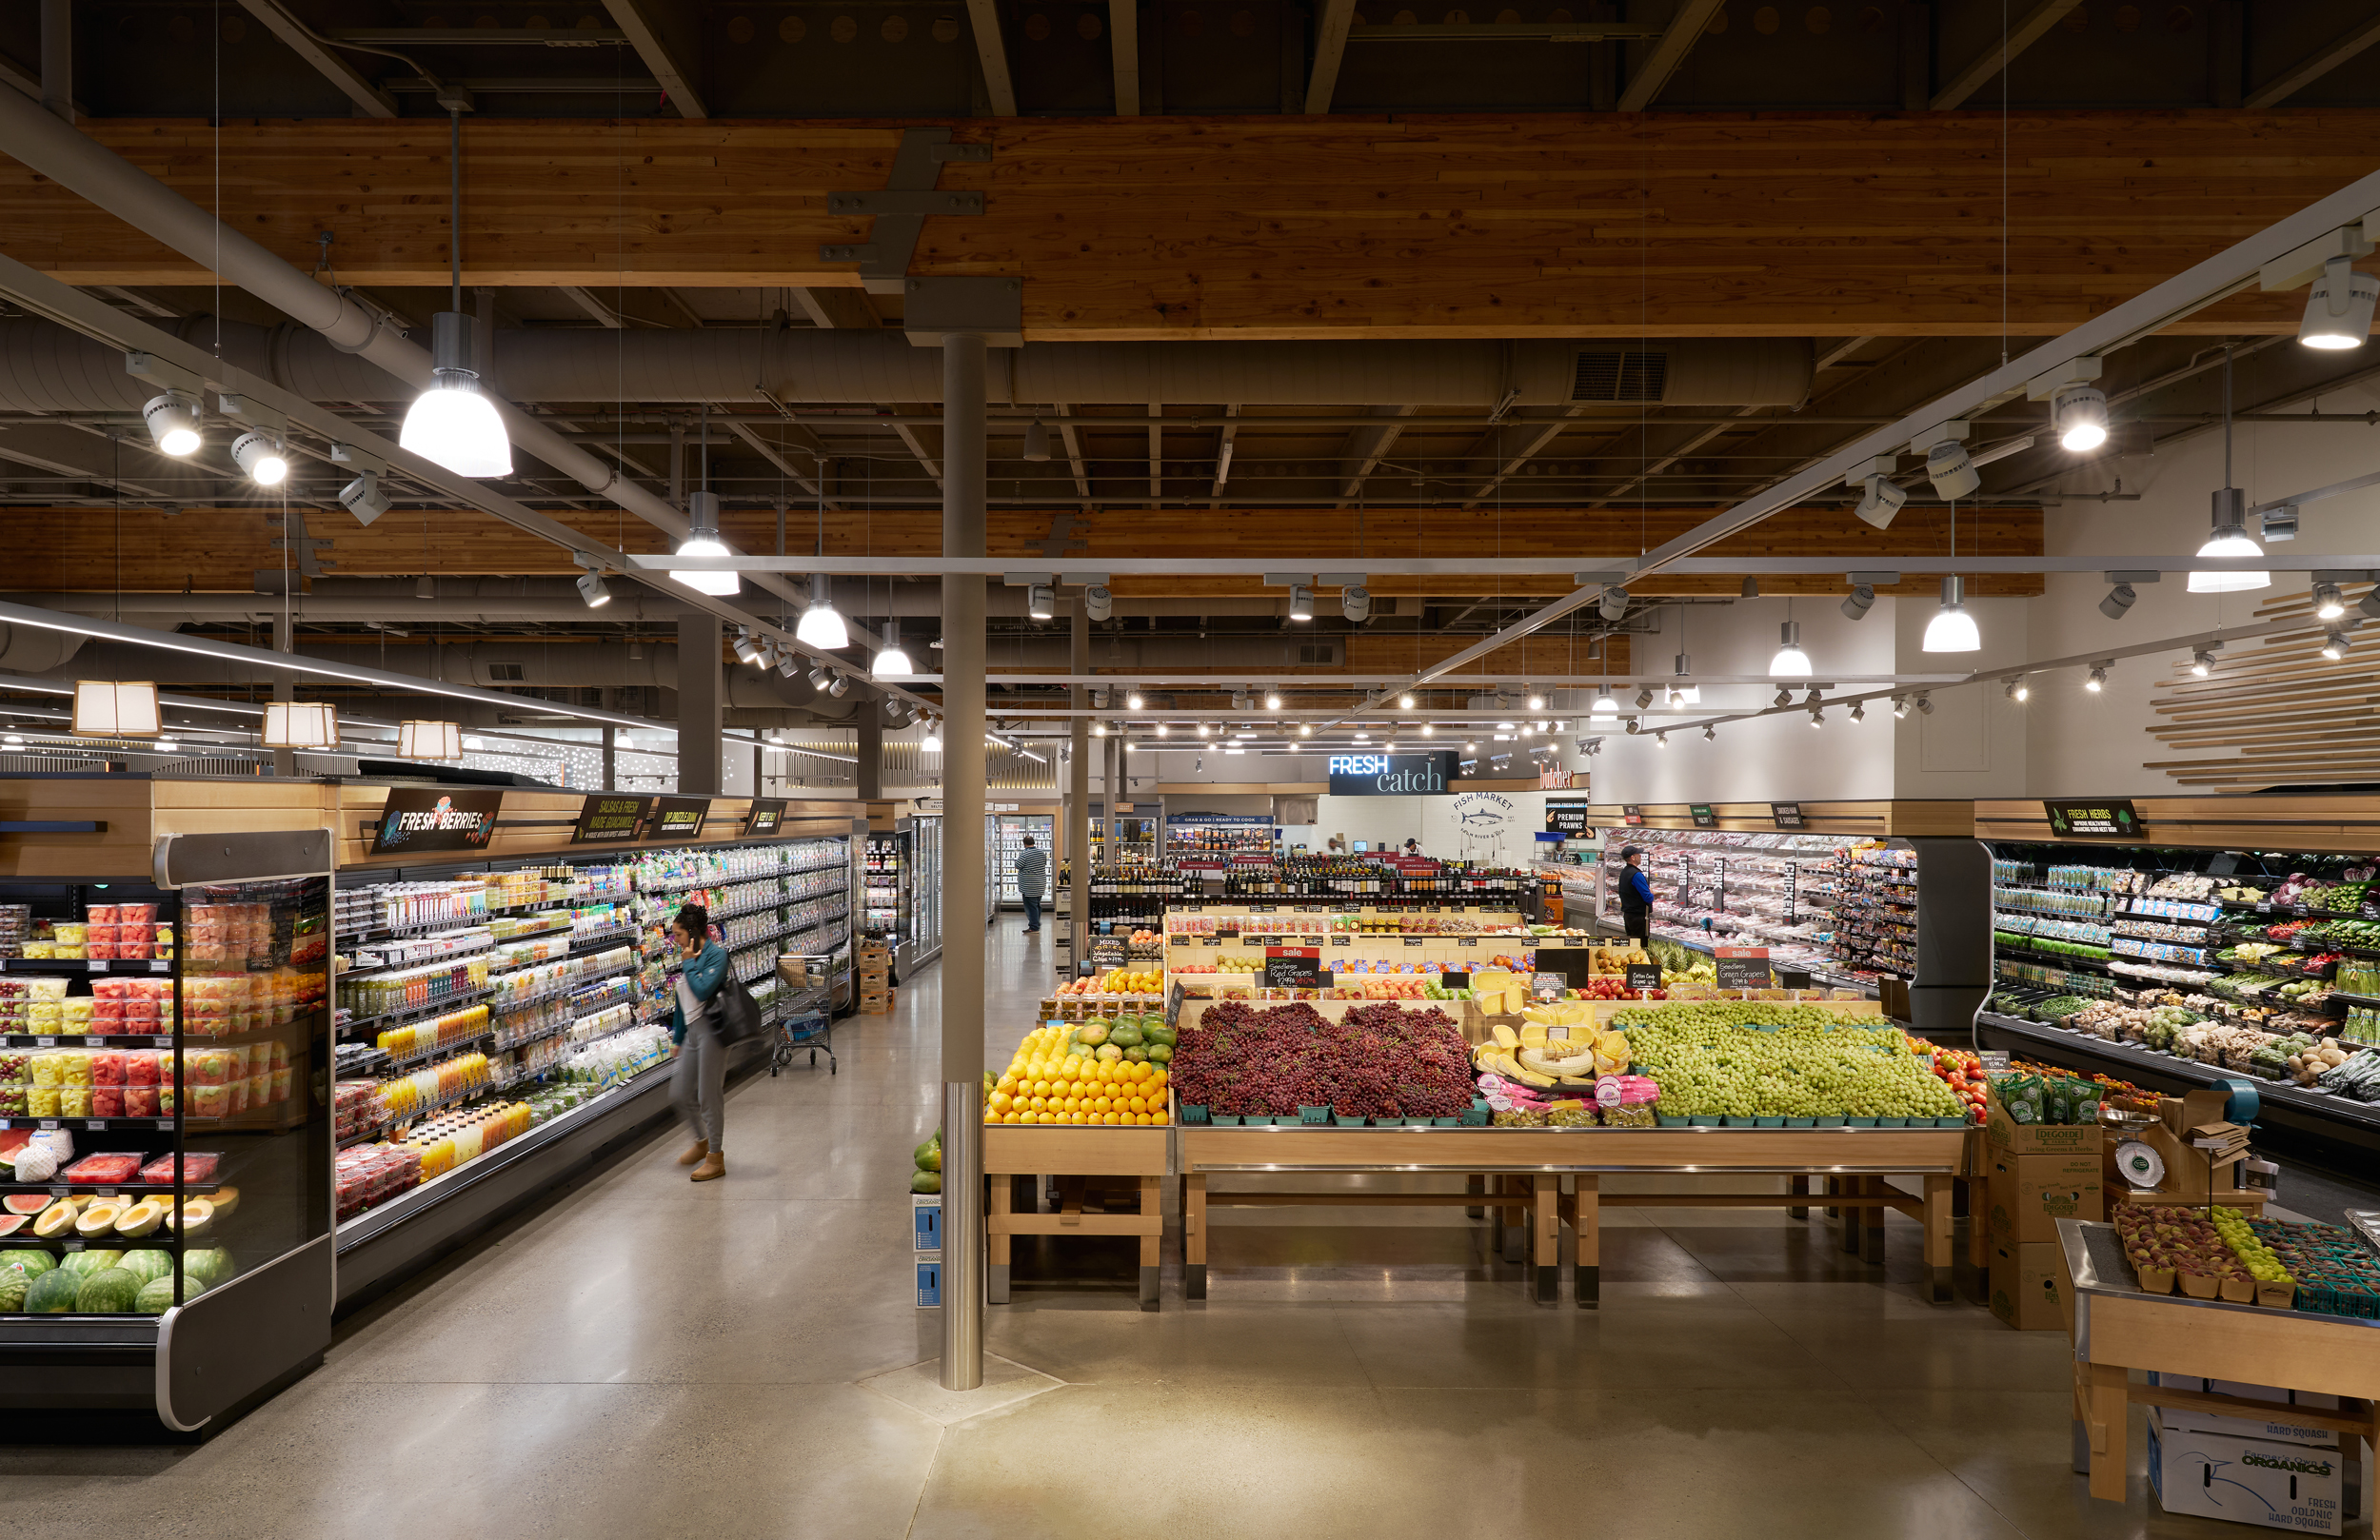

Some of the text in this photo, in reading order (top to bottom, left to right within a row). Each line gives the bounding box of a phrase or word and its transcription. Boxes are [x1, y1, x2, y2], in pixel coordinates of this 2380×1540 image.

[1329, 755, 1388, 775] FRESH
[1377, 761, 1443, 792] catch
[1539, 761, 1574, 789] butcher
[625, 801, 640, 813] FRESH
[1454, 792, 1514, 810] FISH MARKET
[398, 812, 483, 831] FRESH BERRIES
[2067, 809, 2112, 819] FRESH HERBS
[1678, 857, 1687, 886] LAMB
[1714, 859, 1723, 890] PORK
[1784, 864, 1795, 917] CHICKEN
[1282, 948, 1302, 957] sale
[1271, 969, 1313, 978] Red Grapes
[1719, 969, 1765, 979] Green Grapes
[2267, 1425, 2328, 1439] HARD SQUASH
[2242, 1455, 2330, 1476] ORGANICS
[2244, 1451, 2317, 1466] Farmer's Own
[2308, 1497, 2336, 1510] FRESH
[2269, 1512, 2292, 1524] HARD
